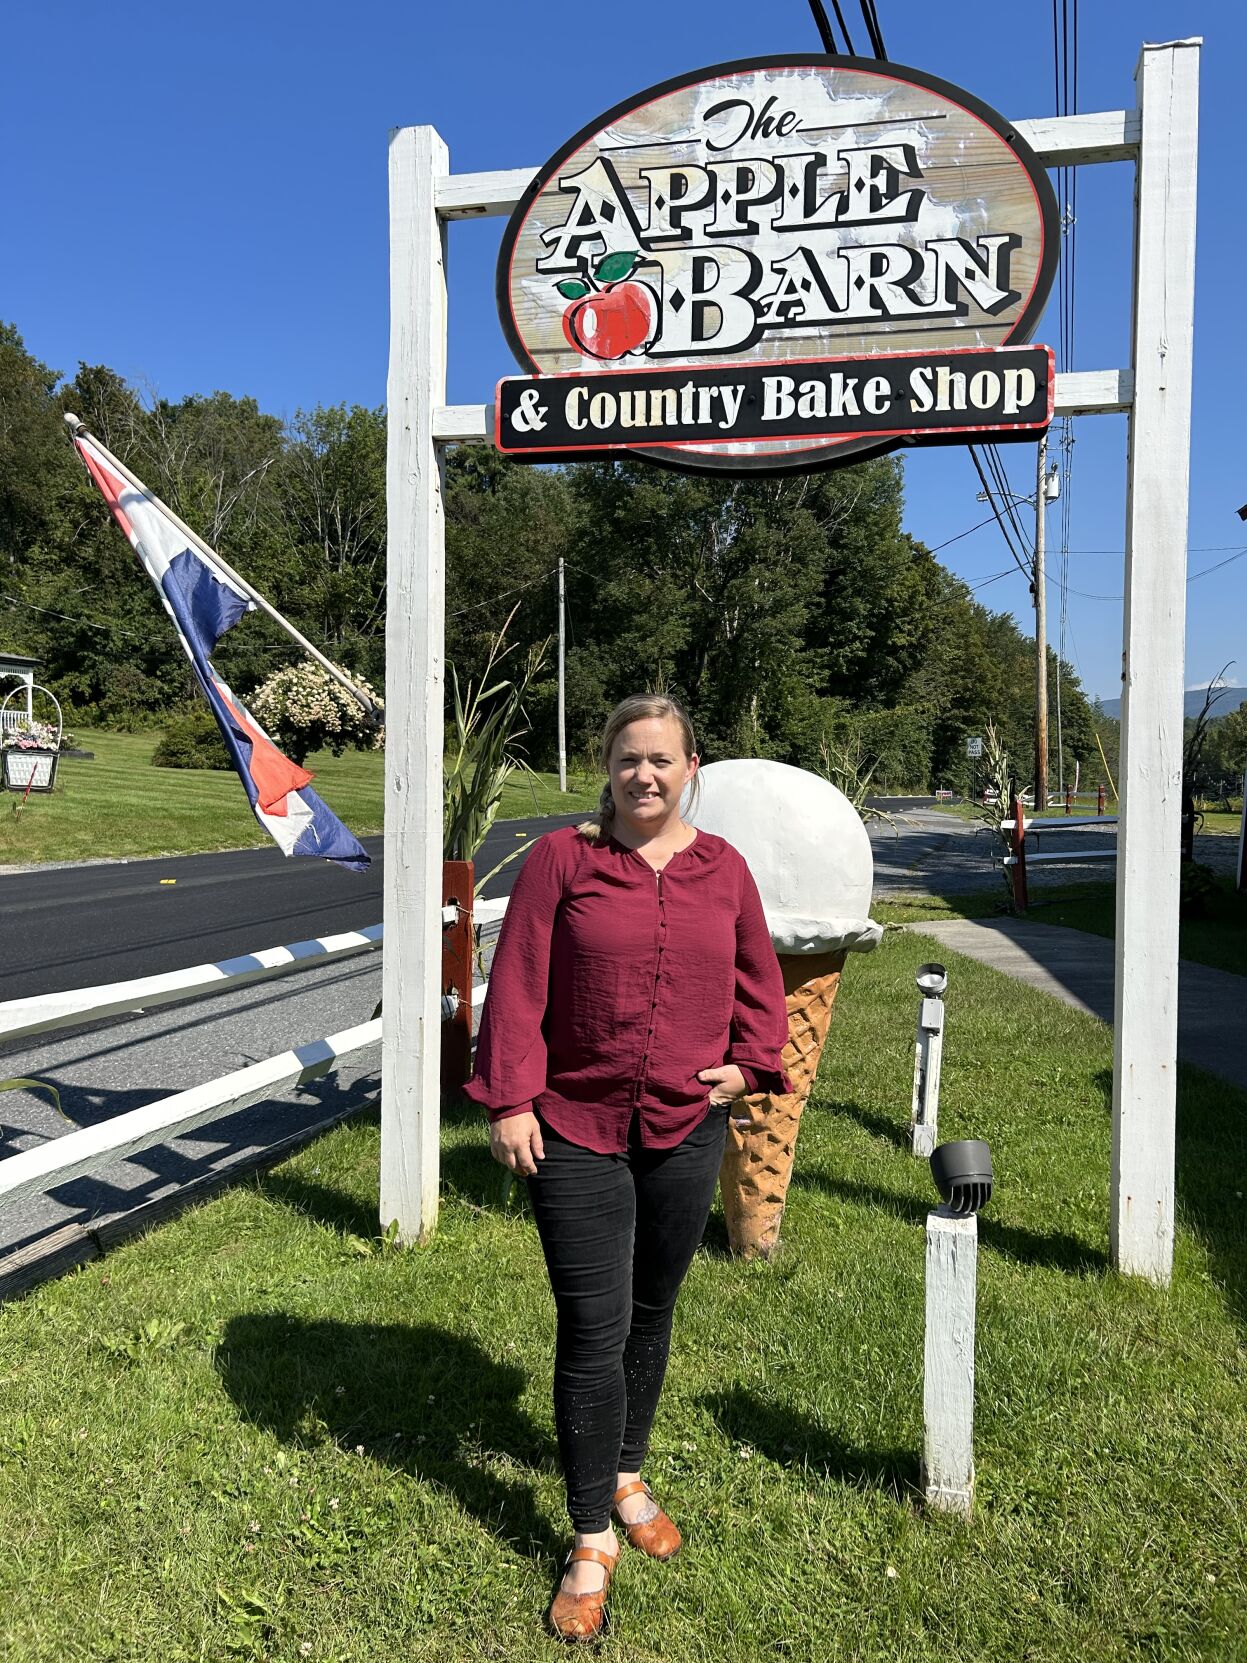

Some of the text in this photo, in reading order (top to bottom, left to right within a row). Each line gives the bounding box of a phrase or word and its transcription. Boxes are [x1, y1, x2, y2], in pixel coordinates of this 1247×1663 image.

[703, 96, 799, 151] The
[537, 144, 926, 274] APPLE
[646, 233, 1022, 358] BARN
[511, 366, 1036, 432] & Country Bake Shop
